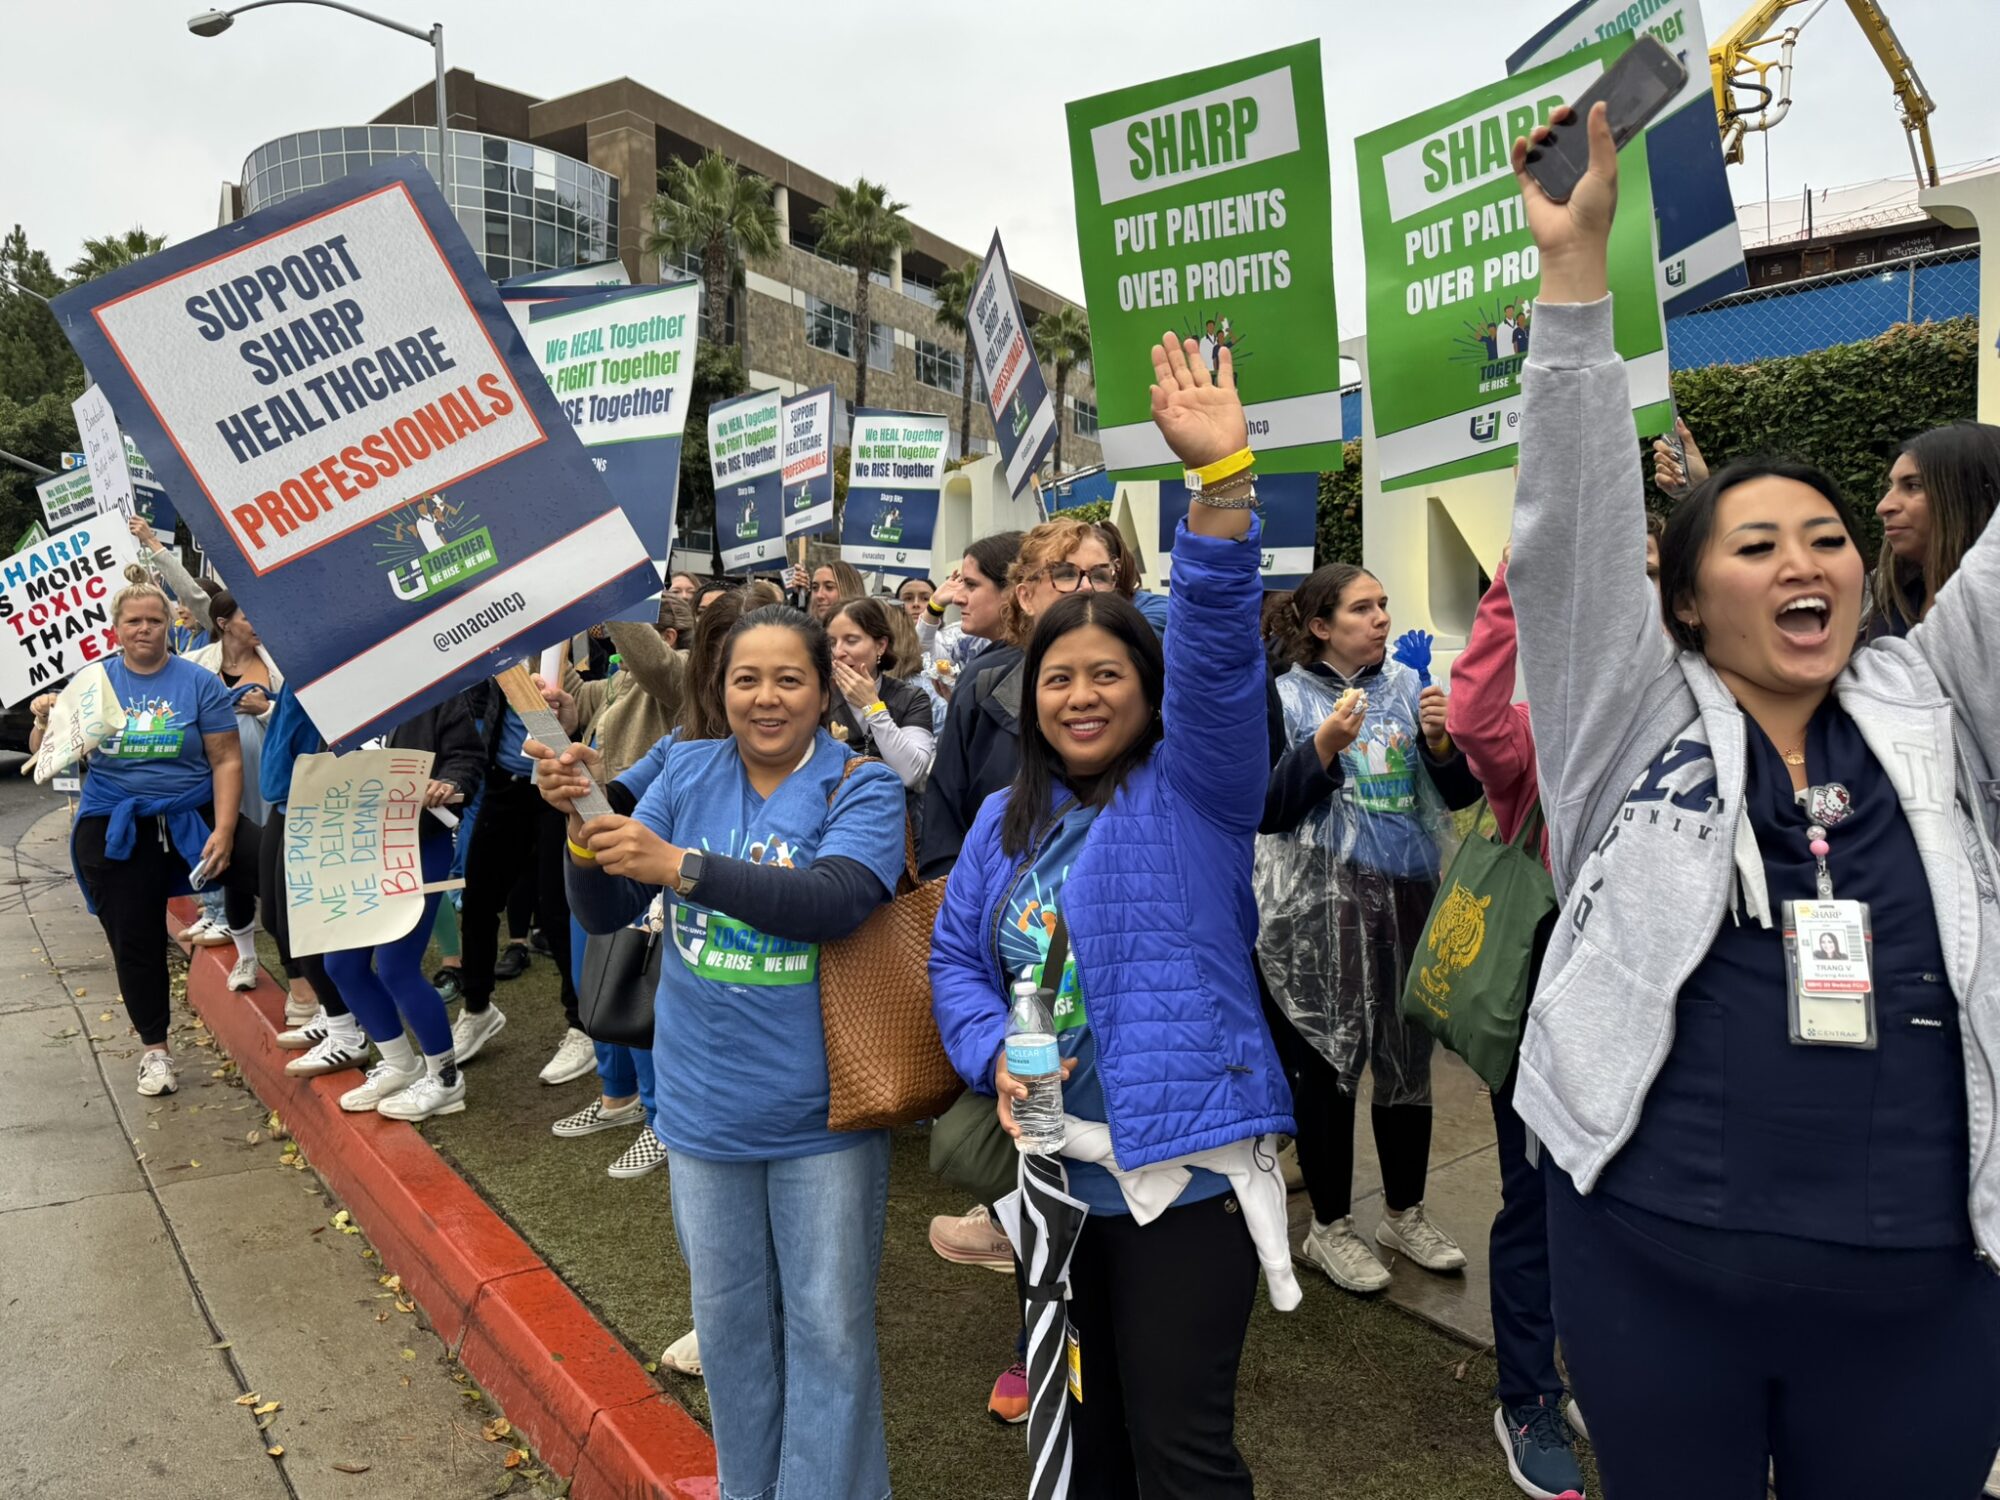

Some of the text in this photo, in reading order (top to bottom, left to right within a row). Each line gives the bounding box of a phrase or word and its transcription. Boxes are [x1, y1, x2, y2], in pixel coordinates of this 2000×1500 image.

[1127, 96, 1259, 182] SHARP
[1114, 187, 1287, 256] PUT PATIENTS
[1405, 193, 1531, 266] PUT PATI
[185, 234, 364, 343] SUPPORT
[976, 271, 997, 325] SUPPORT
[1118, 249, 1291, 312] OVER PROFITS
[1406, 267, 1474, 316] OVER
[239, 298, 366, 387] SHARP
[545, 313, 686, 365] We HEAL Together
[985, 305, 999, 343] SHARP
[985, 309, 1014, 377] HEALTHCARE
[556, 360, 597, 394] FIGHT
[601, 350, 681, 385] Together
[990, 329, 1026, 411] PROFESSIONALS
[1479, 382, 1490, 393] WE
[1491, 377, 1509, 391] RISE
[1481, 356, 1522, 381] TOGET
[215, 326, 457, 465] HEALTHCARE
[560, 386, 673, 425] ISE Together
[790, 402, 818, 424] SUPPORT
[717, 405, 777, 437] We HEAL Together
[793, 420, 814, 439] SHARP
[865, 427, 944, 443] We HEAL Together
[714, 424, 777, 458] We FIGHT Together
[715, 444, 776, 477] We RISE Together
[785, 433, 822, 457] HEALTHCARE
[858, 445, 940, 460] We FIGHT Together
[68, 473, 91, 488] Togethe
[230, 371, 516, 551] PROFESSIONALS
[855, 462, 935, 480] We RISE Together
[60, 505, 72, 517] RISE
[73, 496, 95, 513] Togethe
[70, 485, 93, 500] Togethe
[0, 531, 90, 595] HARP
[425, 534, 487, 573] TOGETHER
[430, 572, 444, 586] WE
[443, 566, 461, 582] RISE
[464, 556, 479, 570] WE
[478, 549, 492, 565] WIN
[26, 545, 116, 603] MORE
[7, 576, 107, 636] TOXIC
[433, 591, 527, 652] @unacuhcp
[20, 603, 107, 658] THAN
[29, 625, 121, 686] MY EX
[124, 745, 177, 753] WE RISE WE WIN
[127, 733, 178, 746] TOGETHER
[1624, 807, 1719, 841] UNIV
[350, 779, 384, 916] WE DEMAND
[288, 870, 315, 909] WE
[320, 884, 348, 924] WE
[1810, 911, 1842, 919] SHARP
[705, 950, 809, 972] WE RISE WE WIN
[1054, 996, 1075, 1018] ISE
[991, 1242, 1010, 1252] HO
